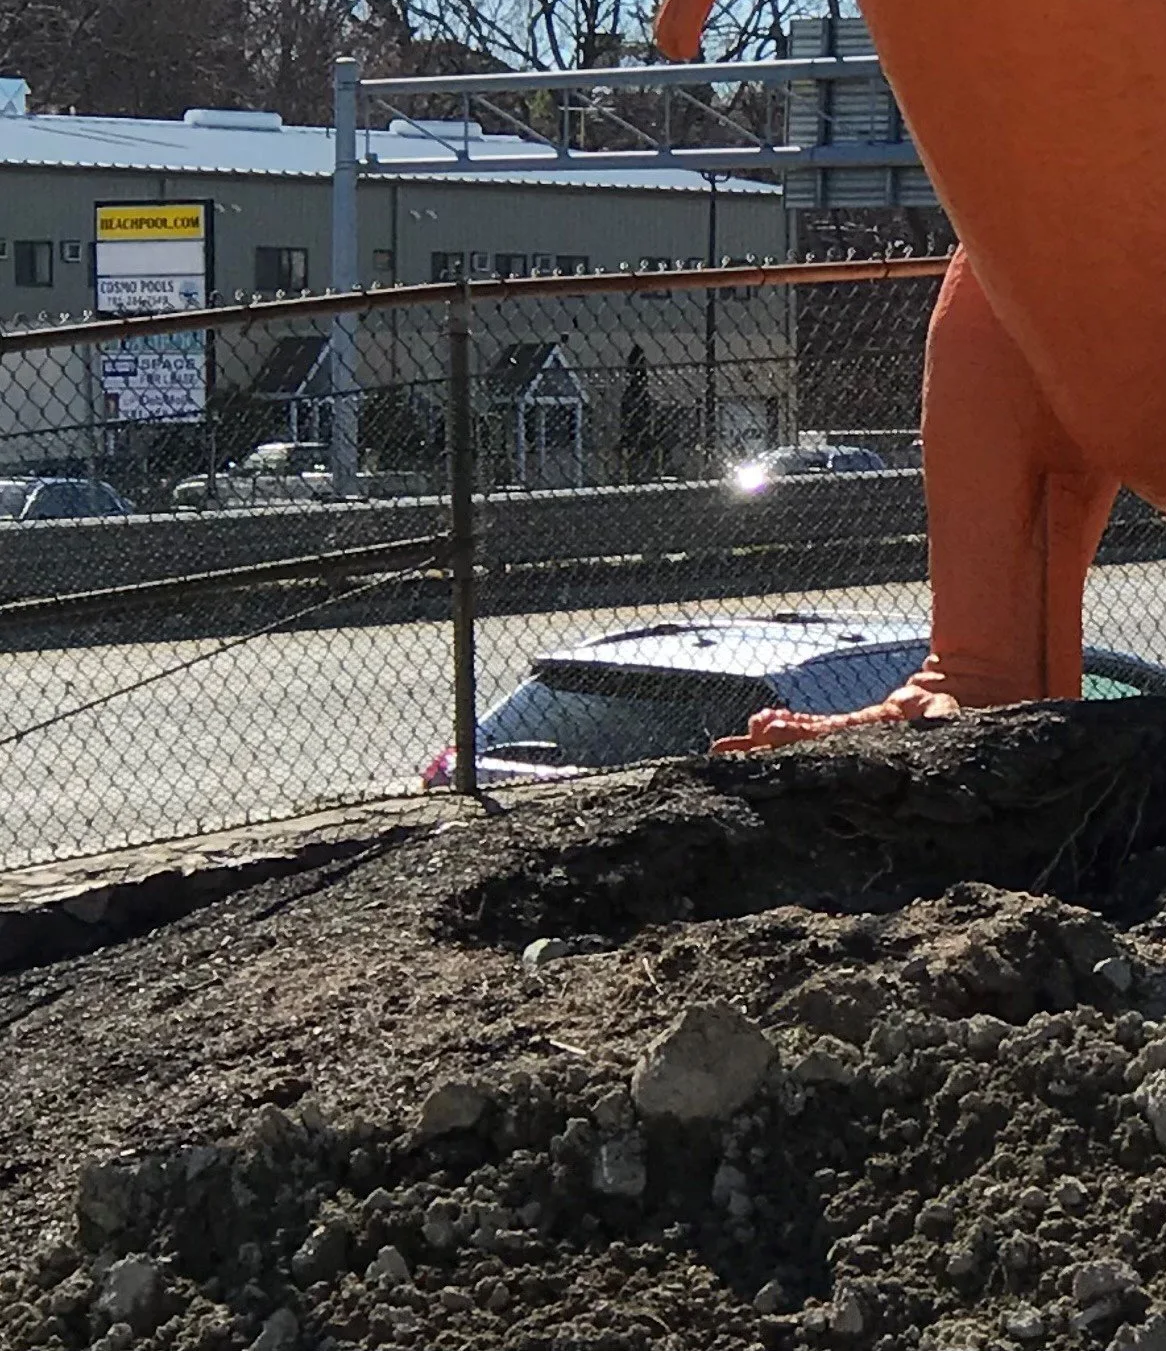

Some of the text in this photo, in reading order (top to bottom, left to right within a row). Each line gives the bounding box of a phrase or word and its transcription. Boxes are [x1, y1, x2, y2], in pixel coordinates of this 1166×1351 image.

[100, 280, 174, 294] COSMO POOLS
[141, 358, 196, 370] SPACE
